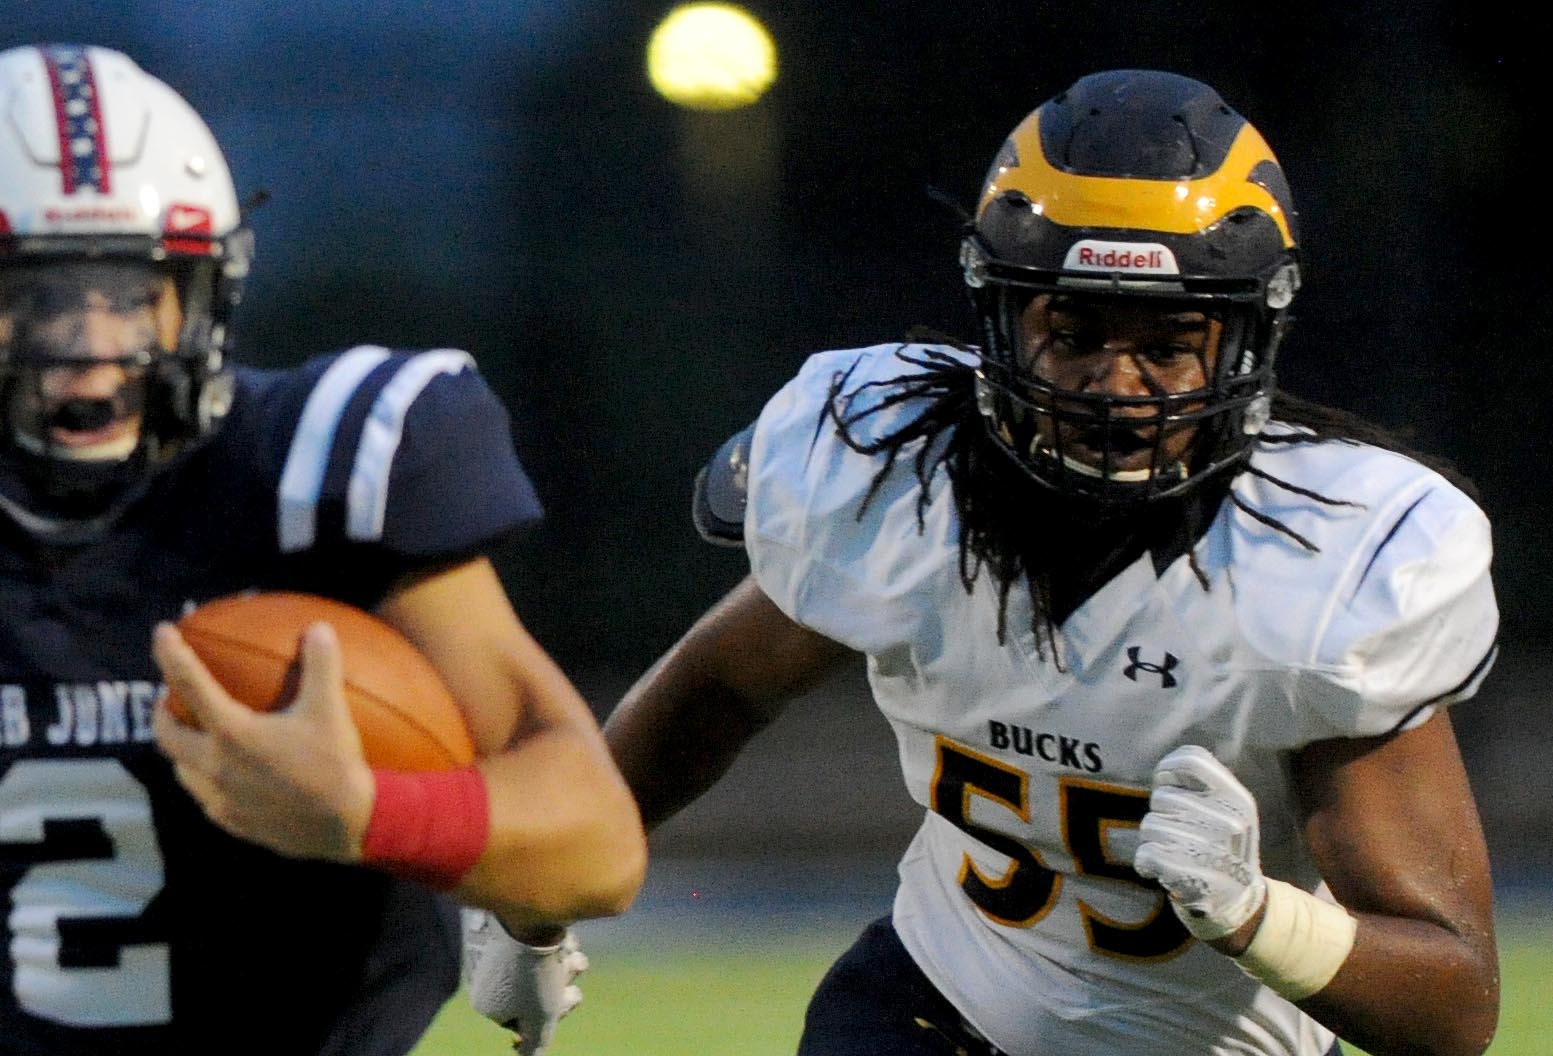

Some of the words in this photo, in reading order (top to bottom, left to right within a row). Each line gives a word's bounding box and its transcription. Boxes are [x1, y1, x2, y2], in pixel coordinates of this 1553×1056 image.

[1079, 247, 1162, 269] Riddell
[46, 680, 169, 746] JONE
[988, 719, 1104, 773] BUCKS
[930, 732, 1196, 965] 55
